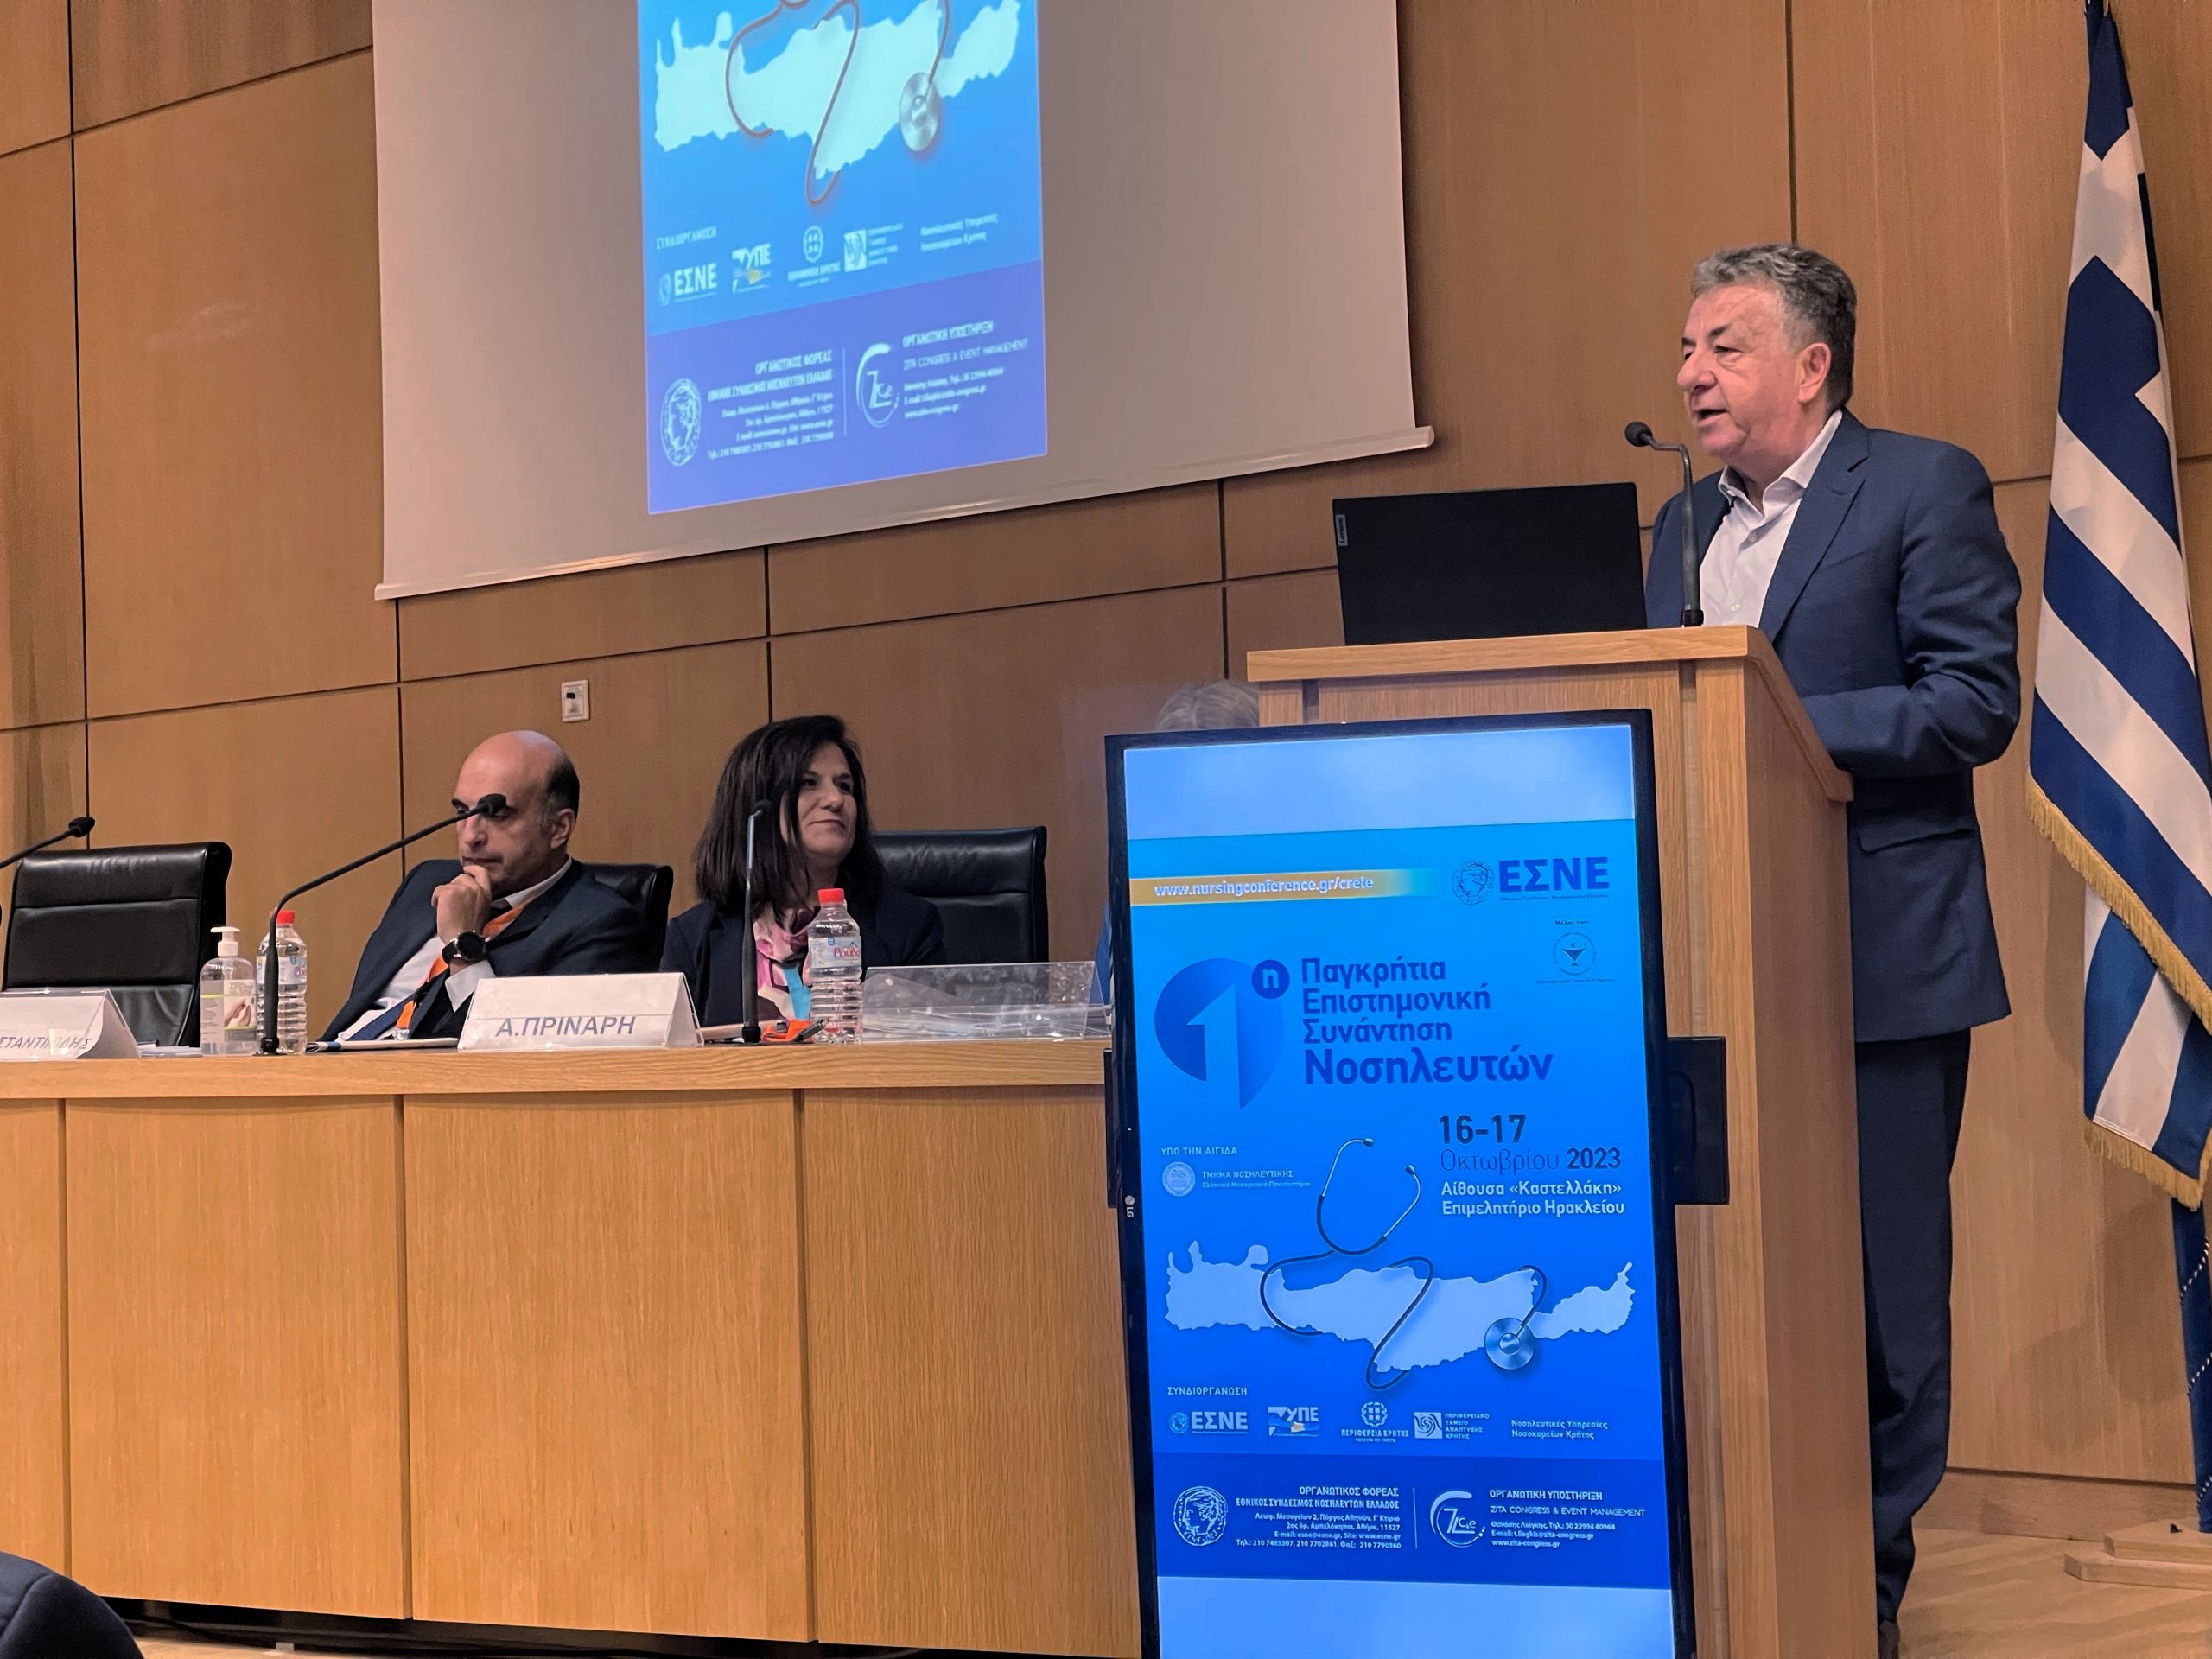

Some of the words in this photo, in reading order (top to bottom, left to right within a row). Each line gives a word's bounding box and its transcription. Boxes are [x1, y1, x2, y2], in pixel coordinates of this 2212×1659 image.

[674, 263, 718, 296] ΕΣΝΕ
[1499, 856, 1610, 893] ΕΣΝΕ
[1154, 876, 1374, 897] www.nursingconference.gr/crete
[1301, 955, 1446, 988] Παγκρήτια
[1303, 982, 1491, 1017] Επιστημονική
[496, 1016, 636, 1037] Α.ΠΡΙΝΑΡΗ
[1303, 1017, 1452, 1044] Συνάντηση
[1305, 1044, 1554, 1085] Νοσηλευτών
[1439, 1114, 1526, 1144] 16-17
[1161, 1147, 1179, 1155] ΥΠΟ
[1183, 1147, 1202, 1155] ΤΗΝ
[1205, 1147, 1237, 1155] ΑΙΓΙΔΑ
[1440, 1148, 1560, 1176] Οκτωβρίου
[1566, 1147, 1622, 1169] 2023
[1441, 1181, 1504, 1196] Αίθουσα
[1510, 1180, 1622, 1196] «Καστελλάκη»
[1126, 1206, 1134, 1218] LG
[1442, 1200, 1541, 1218] Επιμελητήριο
[1545, 1199, 1624, 1218] Ηρακλείου
[1167, 1386, 1247, 1395] ΣΥΝΔΙΟΡΓΑΝΩΣΗ
[1191, 1411, 1248, 1430] ΕΣΝΕ
[1511, 1420, 1565, 1429] Νοσηλευτικές
[1567, 1420, 1608, 1430] Υπηρεσίες
[1341, 1429, 1382, 1438] ΠΕΡΙΦΕΡΕΙΑ
[1383, 1429, 1409, 1438] ΚΡΗΤΗΣ
[1512, 1429, 1564, 1440] Νοσοκομείων
[1566, 1430, 1594, 1440] Κρήτης
[1299, 1486, 1361, 1496] ΟΡΓΑΝΩΤΙΚΟΣ
[1362, 1487, 1399, 1497] ΦΟΡΕΑΣ
[1490, 1490, 1546, 1499] ΟΡΓΑΝΩΤΙΚΗ
[1548, 1491, 1603, 1500] ΥΠΟΣΤΗΡΙΞΗ
[1236, 1497, 1268, 1506] ΕΘΝΙΚΟΣ
[1268, 1498, 1313, 1507] ΣΥΝΔΕΣΜΟΣ
[1314, 1499, 1364, 1508] ΝΟΣΗΛΕΥΤΩΝ
[1366, 1500, 1399, 1509] ΕΛΛΑΔΟΣ
[1590, 1508, 1645, 1516] MANAGEMENT
